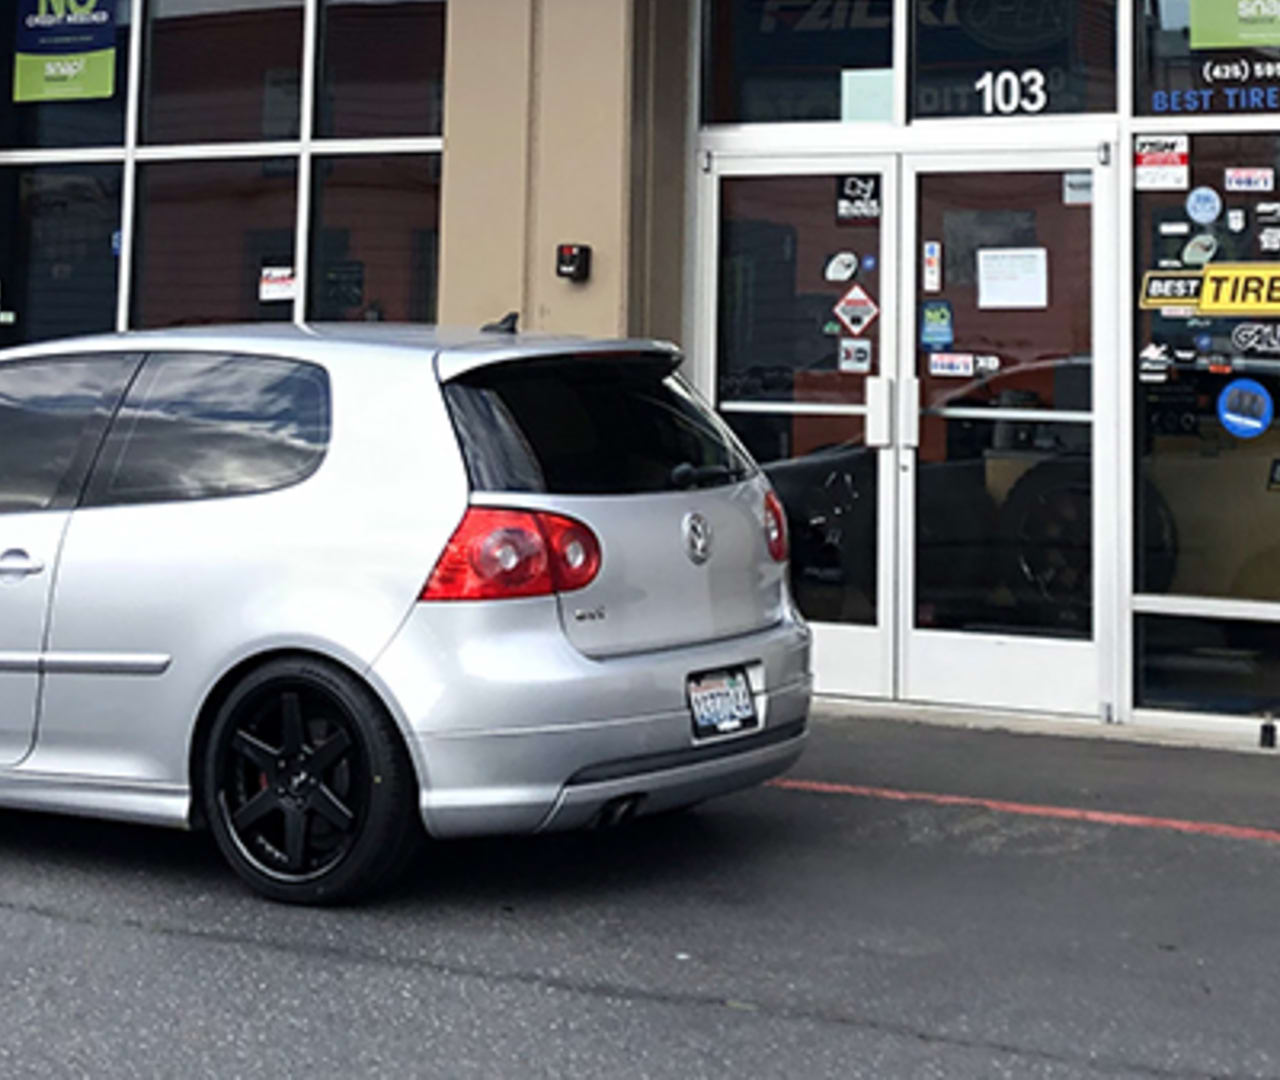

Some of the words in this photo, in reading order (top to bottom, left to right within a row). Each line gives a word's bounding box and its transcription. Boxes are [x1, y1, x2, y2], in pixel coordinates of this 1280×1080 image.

[1202, 59, 1250, 83] (425)
[975, 68, 1047, 114] 103
[1152, 90, 1213, 112] BEST
[1224, 87, 1279, 109] TIRE
[1149, 279, 1200, 296] BEST
